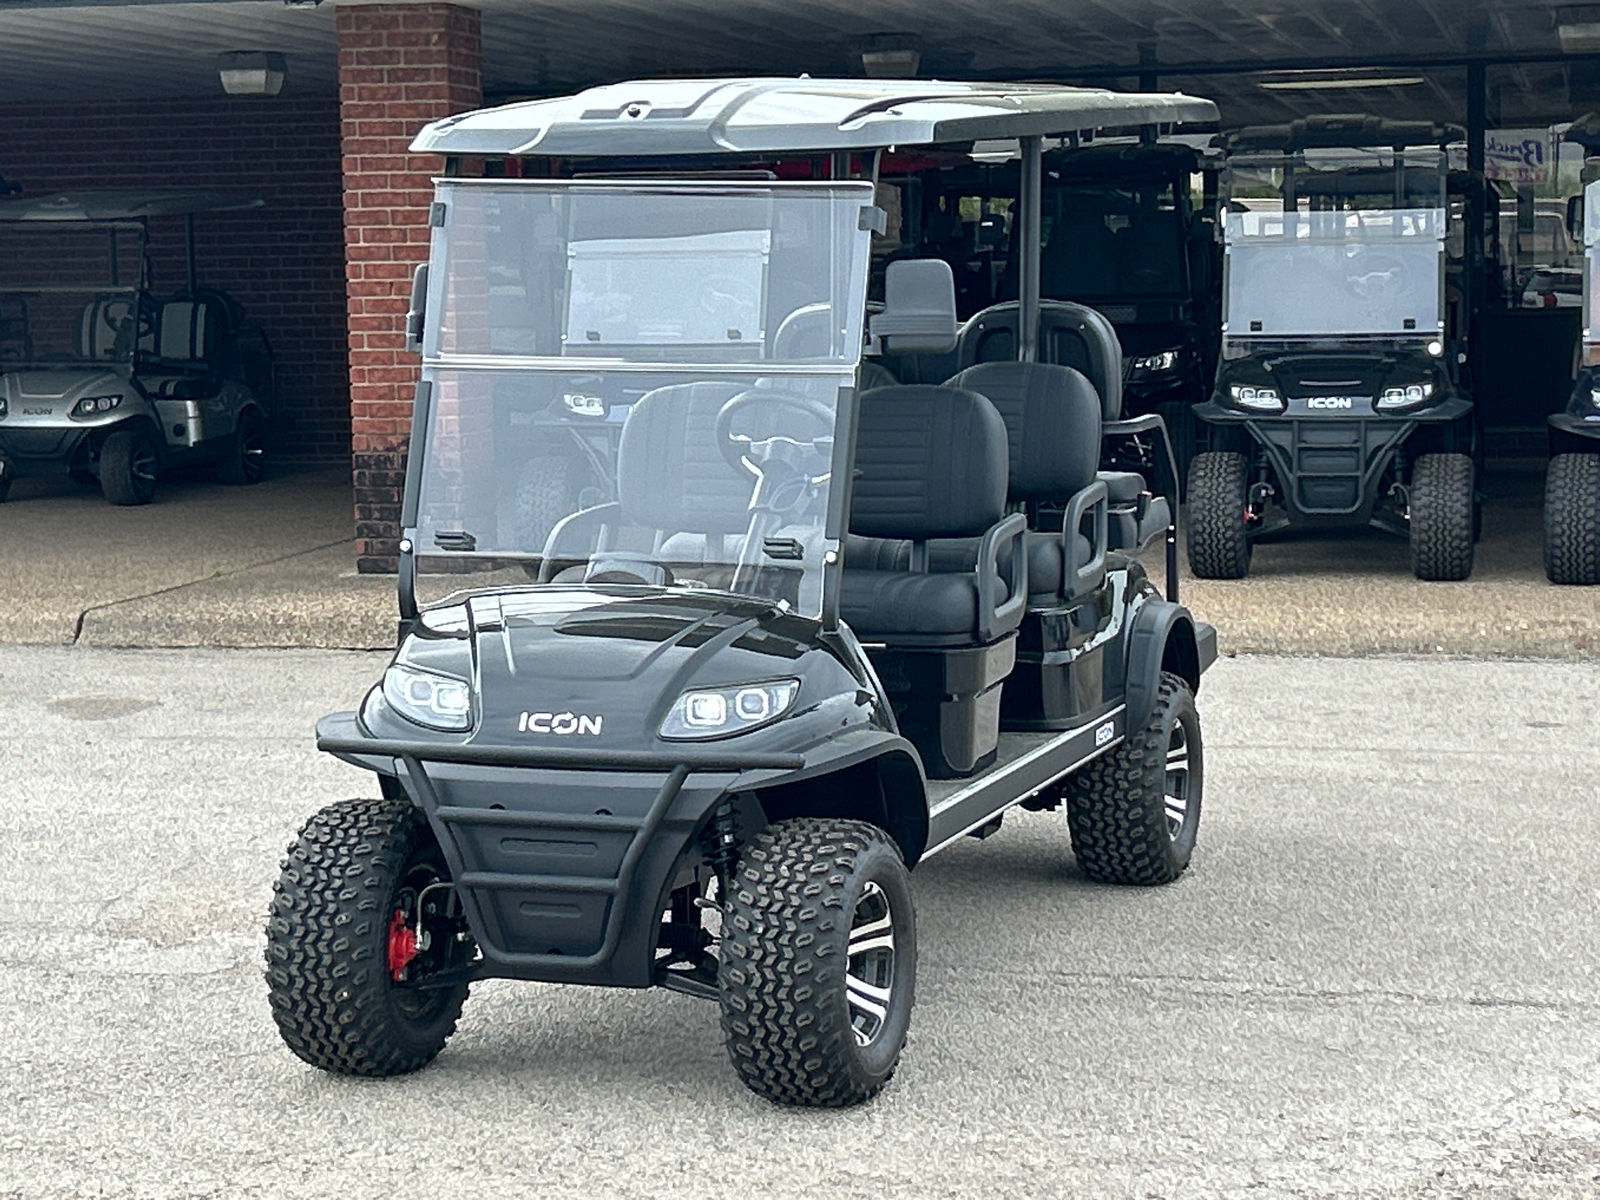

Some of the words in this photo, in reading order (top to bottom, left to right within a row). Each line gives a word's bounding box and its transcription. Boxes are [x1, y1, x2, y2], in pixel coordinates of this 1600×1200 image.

[1308, 396, 1352, 409] ICON
[22, 407, 53, 416] ICON
[518, 711, 603, 736] ICON
